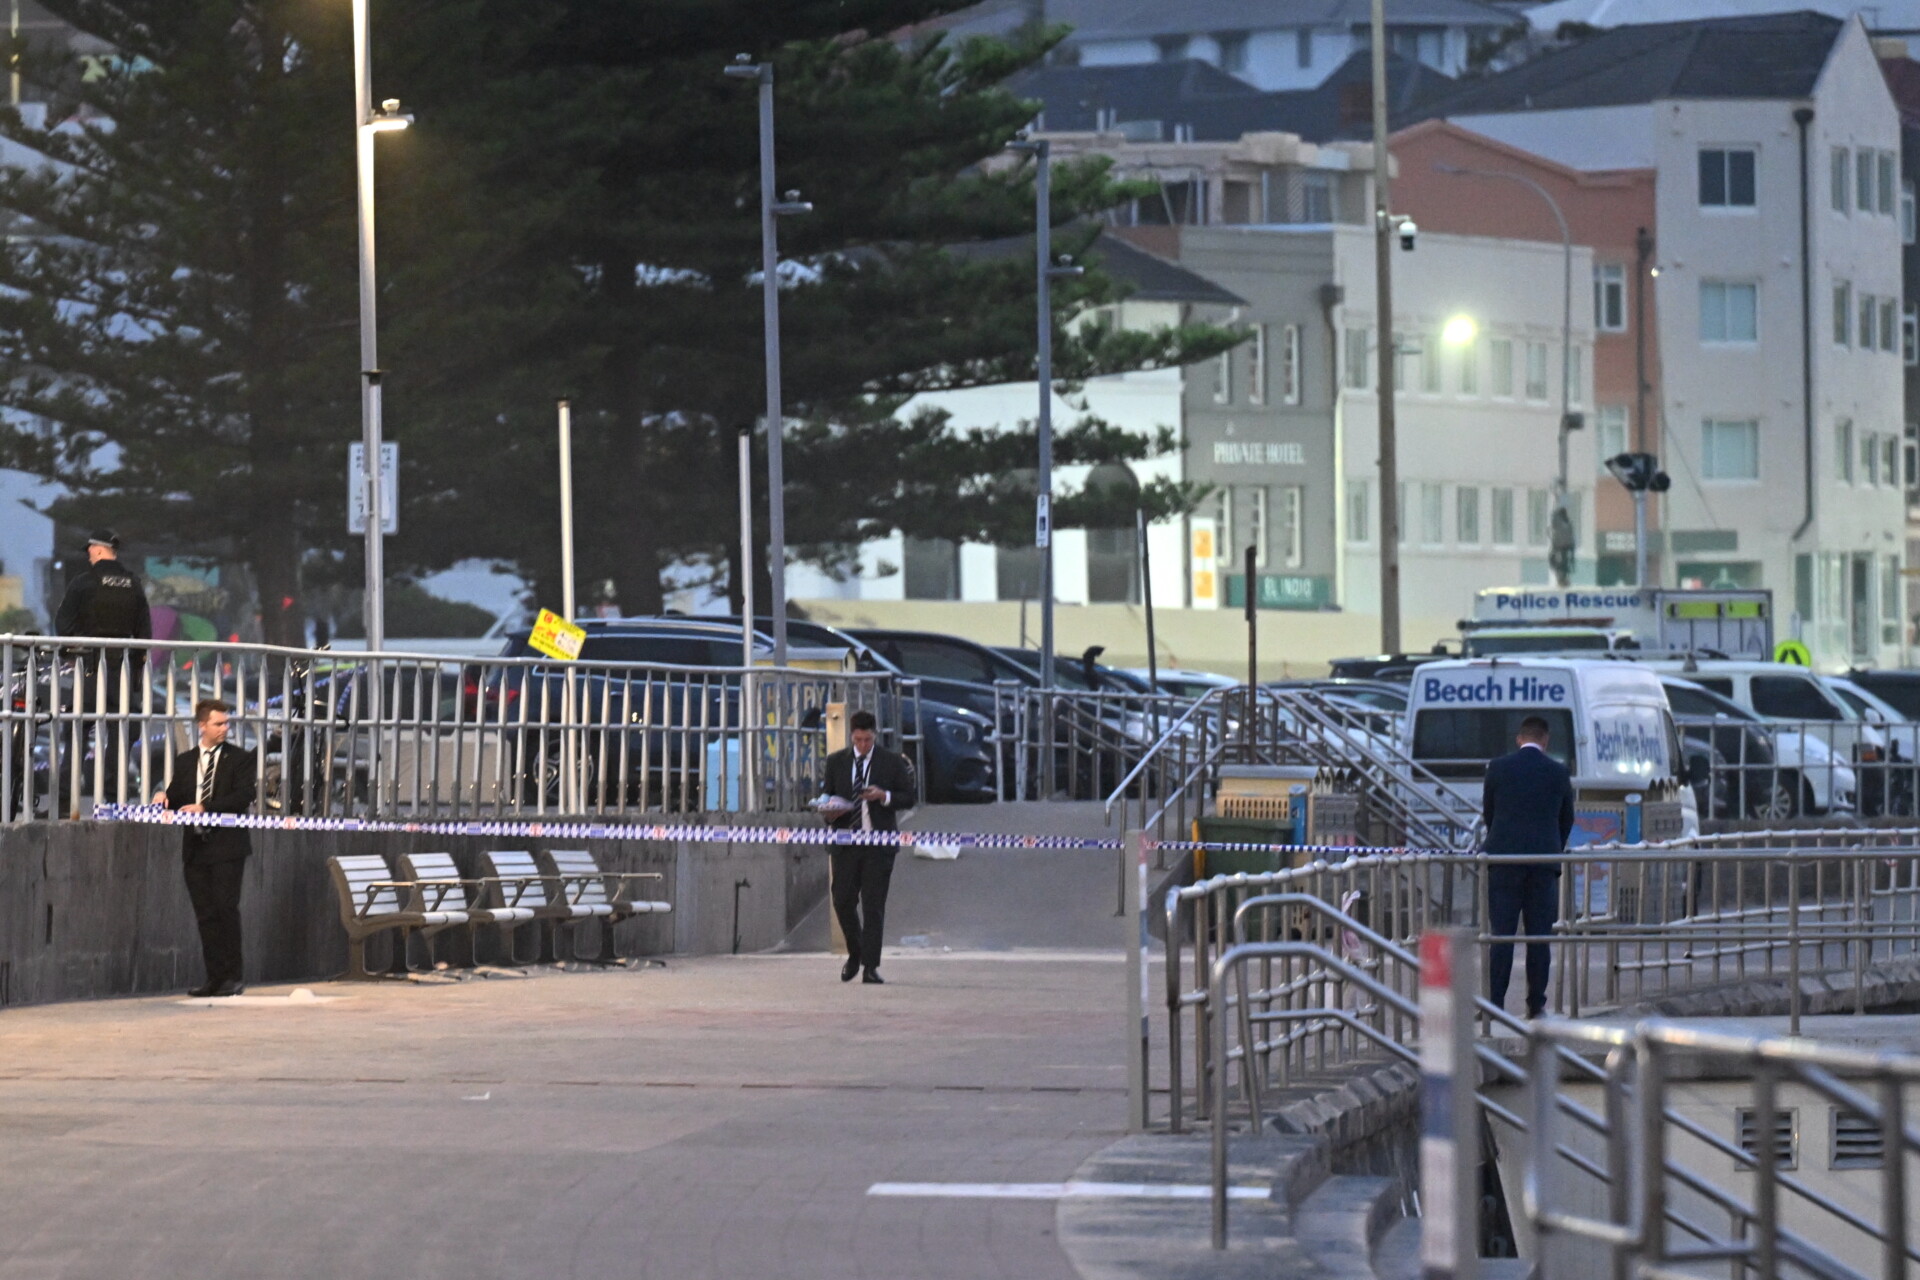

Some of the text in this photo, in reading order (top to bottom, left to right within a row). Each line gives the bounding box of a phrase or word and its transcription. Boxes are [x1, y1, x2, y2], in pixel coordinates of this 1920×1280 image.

[1214, 442, 1304, 464] PRIVATE HOTEL
[102, 576, 132, 588] POLICE
[1496, 592, 1640, 609] Police Rescue
[1425, 676, 1565, 702] Beach Hire
[1594, 720, 1621, 762] Beach
